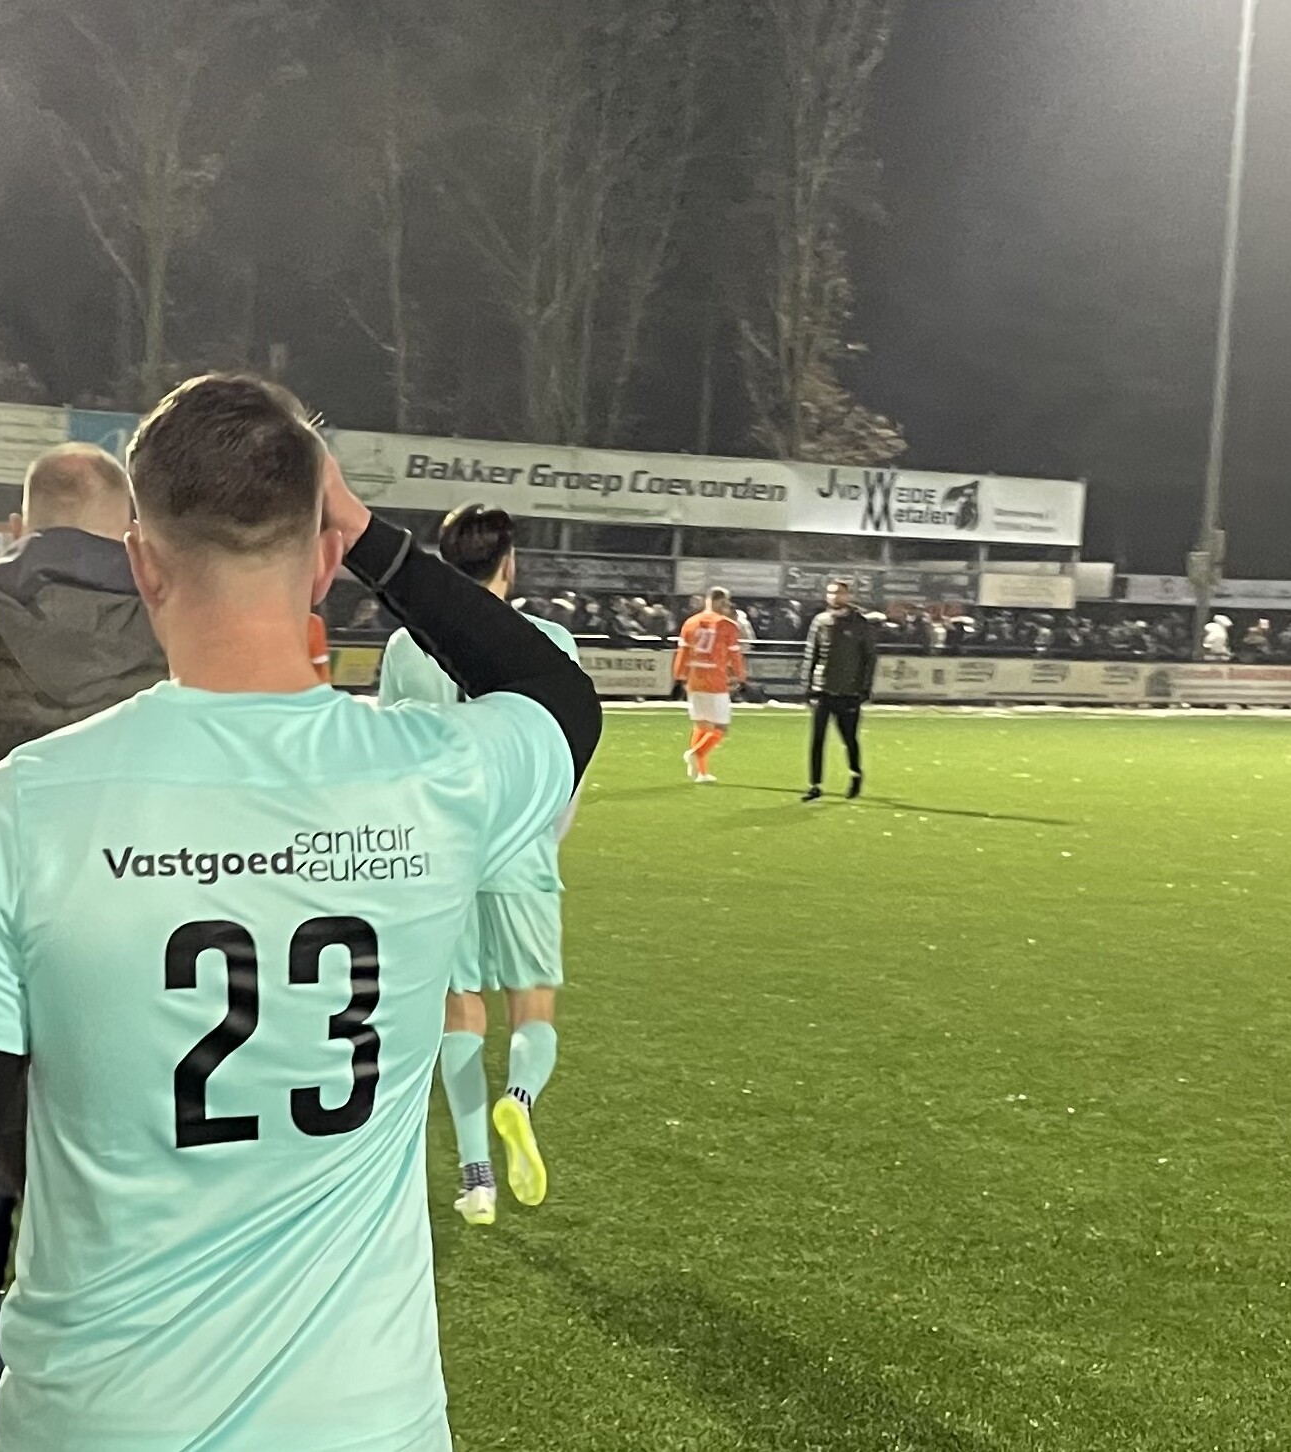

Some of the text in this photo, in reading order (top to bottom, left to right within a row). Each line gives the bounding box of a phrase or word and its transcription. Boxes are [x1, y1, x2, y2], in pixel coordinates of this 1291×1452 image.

[406, 453, 788, 502] Bakker Groep Coevorden
[295, 824, 415, 855] sanitair
[103, 845, 295, 885] Vastgoed
[164, 915, 381, 1148] 23
